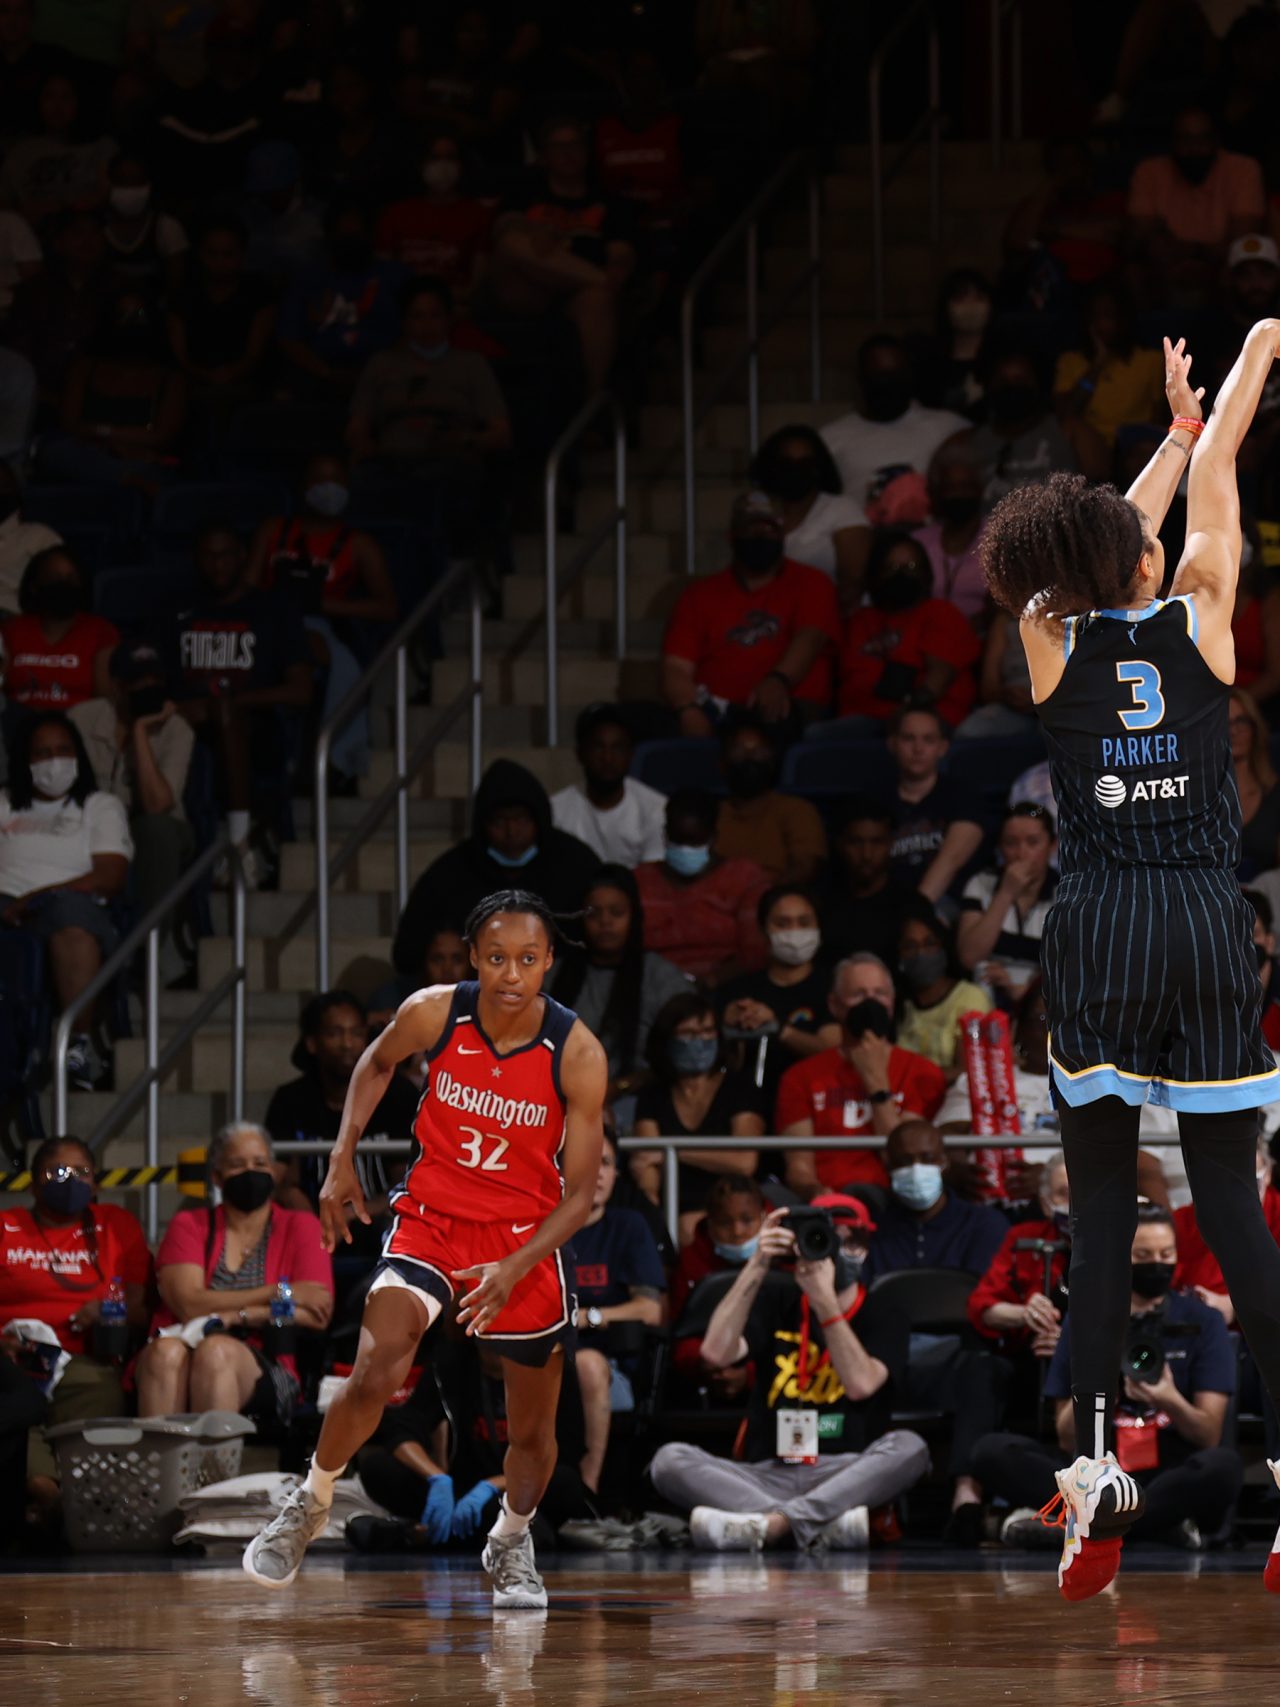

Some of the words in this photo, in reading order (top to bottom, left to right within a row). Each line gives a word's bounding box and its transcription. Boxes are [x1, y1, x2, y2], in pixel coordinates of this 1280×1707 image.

[1115, 659, 1167, 731] 3
[1101, 732, 1179, 768] PARKER
[1131, 775, 1190, 803] AT&T
[435, 1069, 548, 1130] Washington
[455, 1125, 510, 1172] 32
